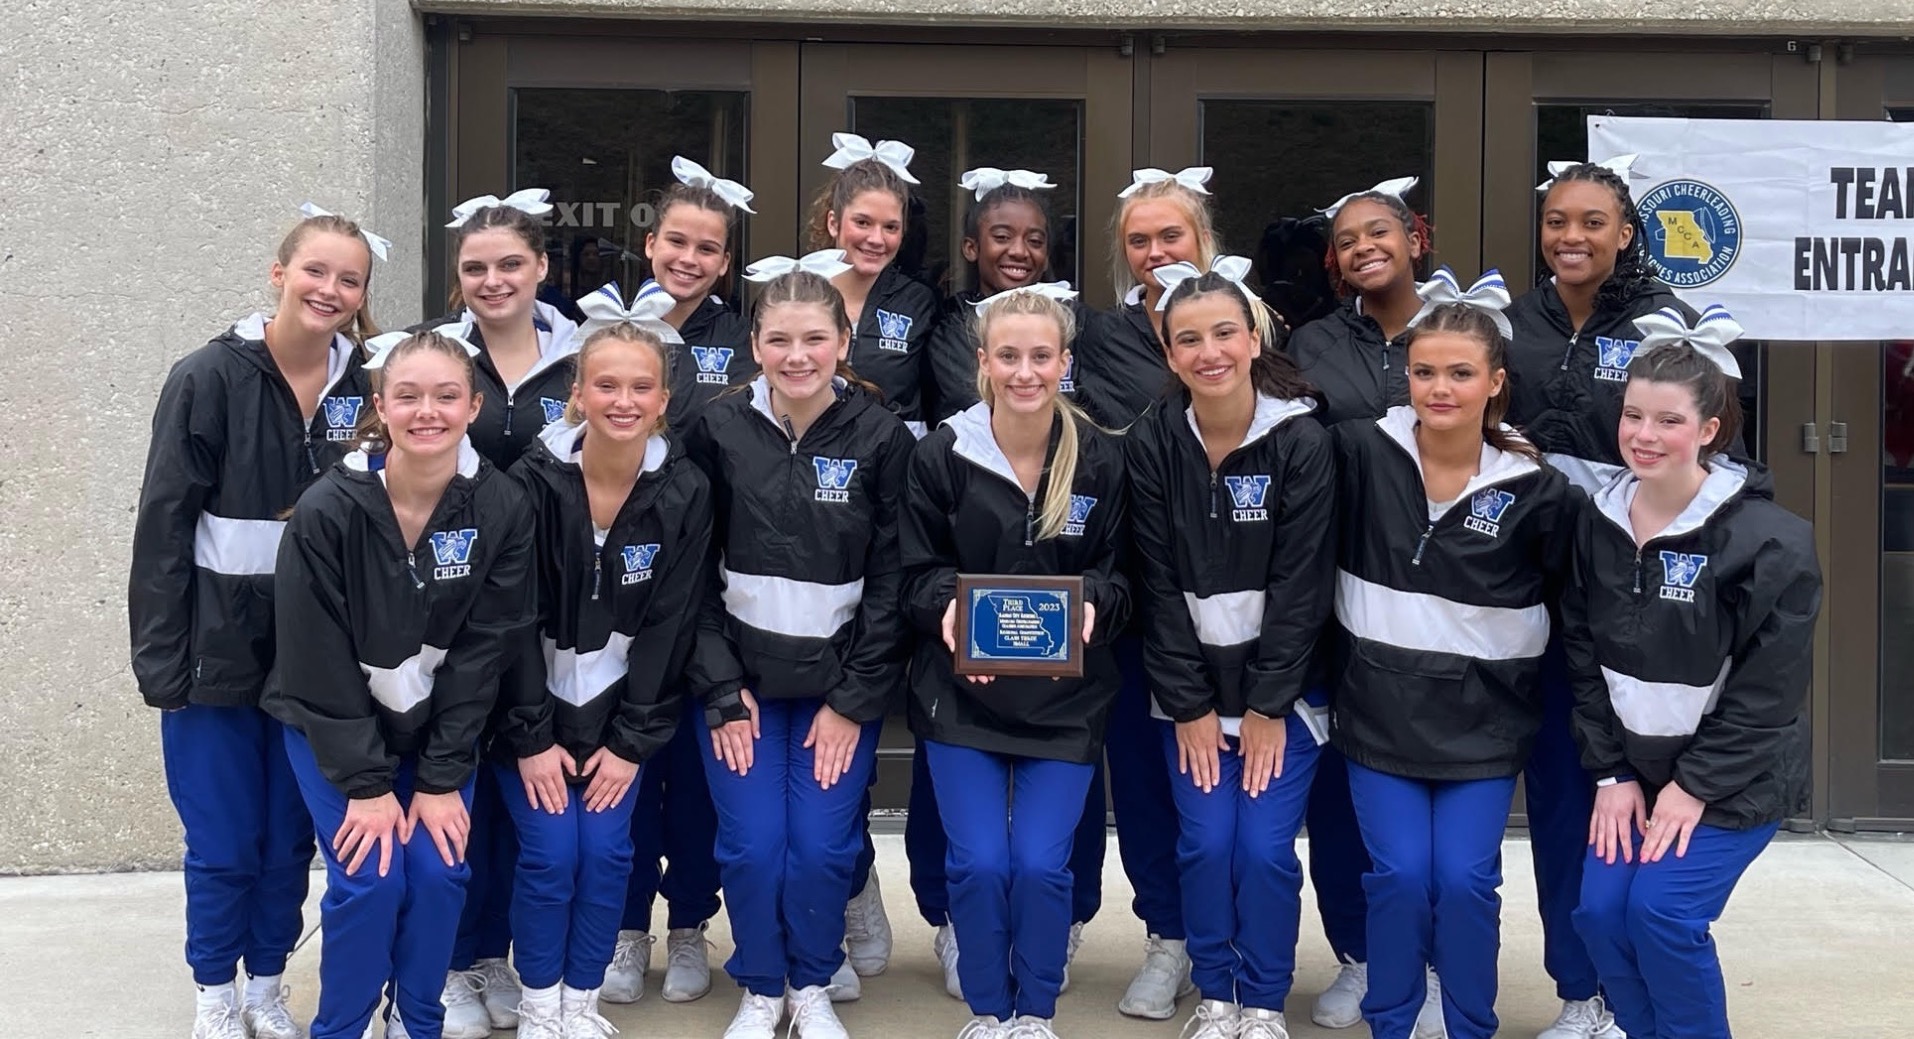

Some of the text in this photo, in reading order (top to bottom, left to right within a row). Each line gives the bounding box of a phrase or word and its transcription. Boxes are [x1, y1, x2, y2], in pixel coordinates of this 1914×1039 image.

[1830, 167, 1914, 219] TEA
[1638, 184, 1736, 235] SSOURI CHEERLEADING
[1674, 246, 1734, 284] ASSOCIATION
[1794, 237, 1914, 291] ENTRA
[876, 308, 913, 340] W
[691, 346, 734, 373] W
[879, 338, 909, 353] CHEER
[696, 373, 729, 385] CHEER
[1058, 380, 1075, 392] EER
[1594, 367, 1629, 382] CHEER
[322, 396, 364, 428] W
[812, 456, 858, 489] W
[814, 489, 849, 503] CHEER
[1224, 475, 1271, 508] W
[1471, 487, 1515, 523] W
[1232, 509, 1268, 522] CHEER
[1463, 515, 1500, 538] CHEER
[428, 528, 478, 565] W
[620, 543, 660, 572] W
[434, 564, 471, 581] CHEER
[621, 569, 652, 586] CHEER
[1659, 550, 1708, 588] W
[1039, 603, 1060, 611] 2023
[1659, 585, 1695, 603] CHEER
